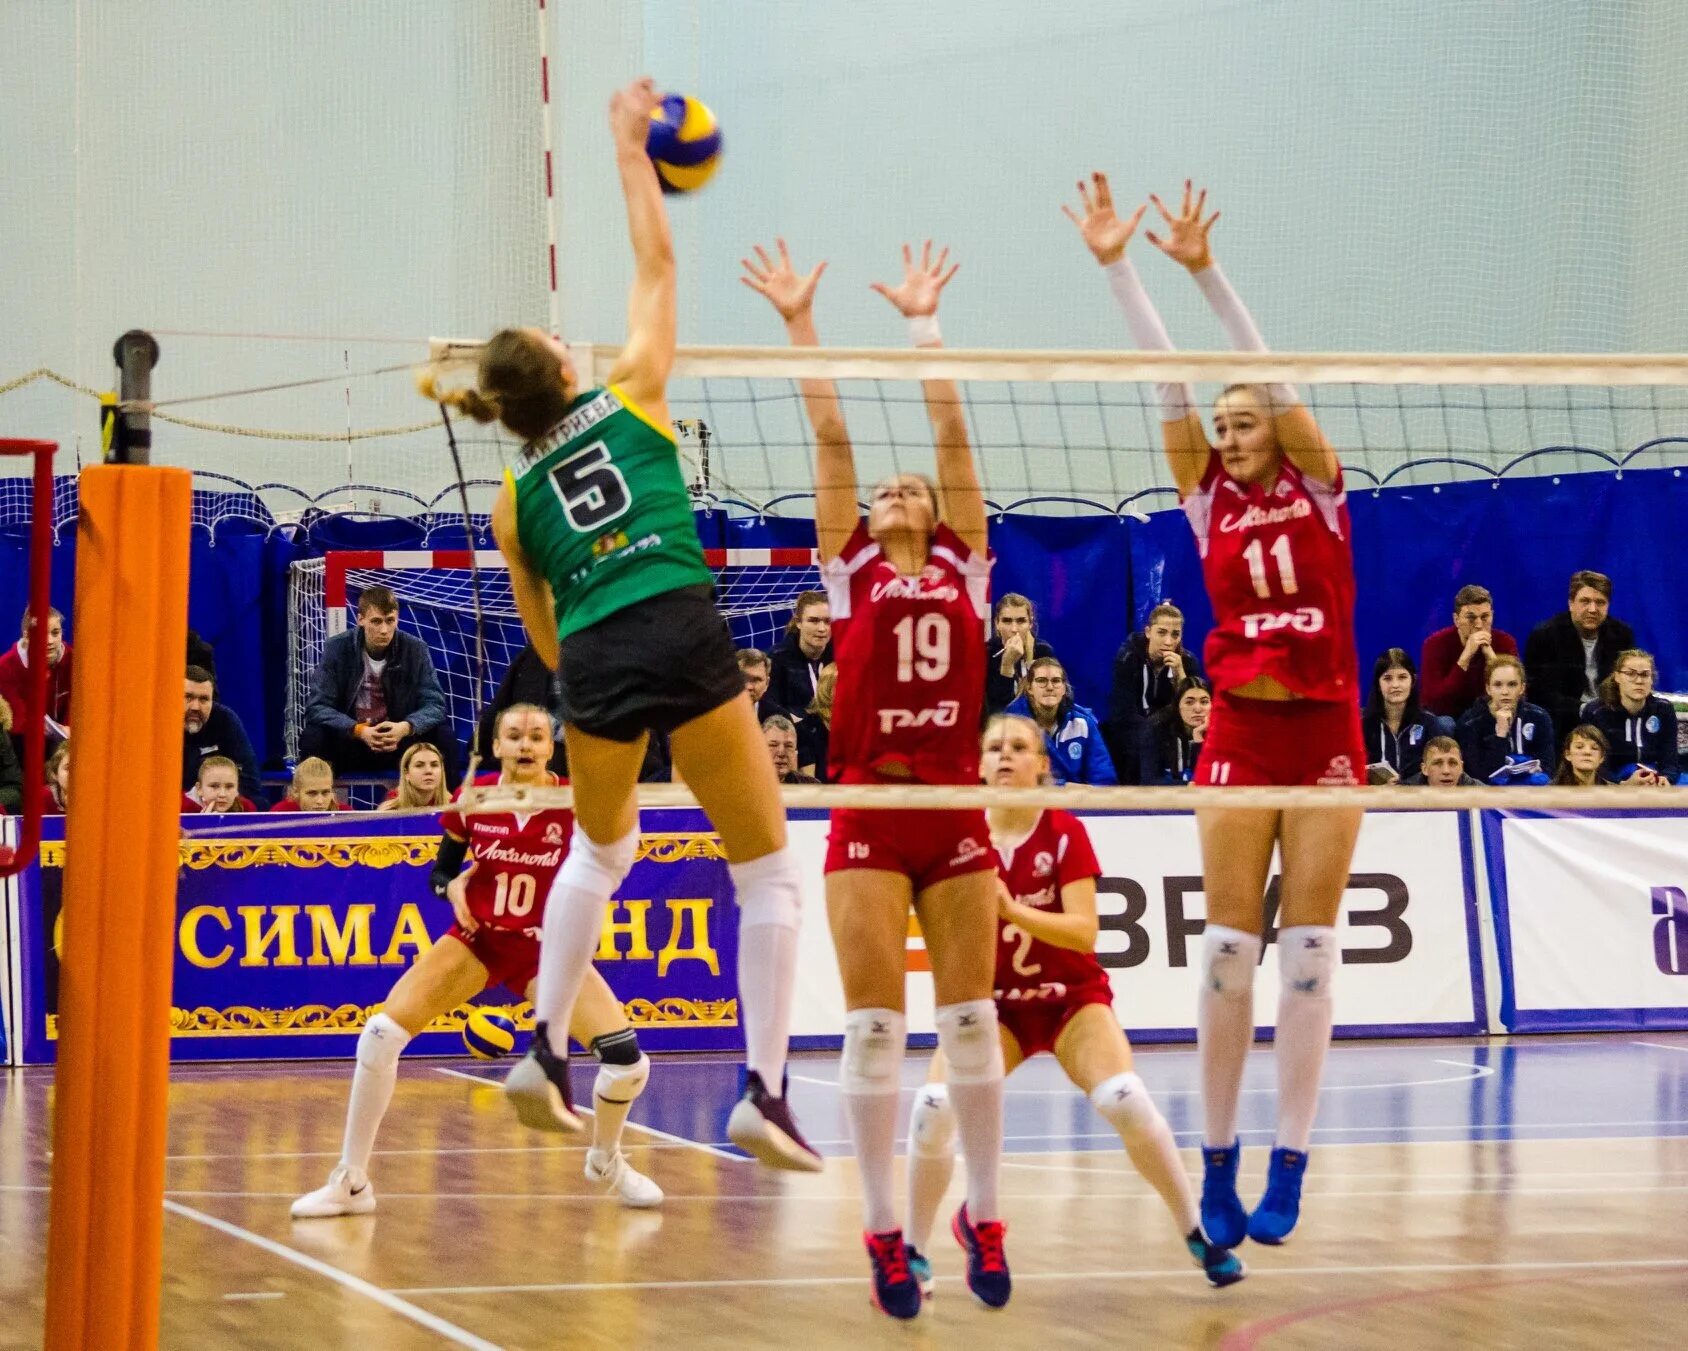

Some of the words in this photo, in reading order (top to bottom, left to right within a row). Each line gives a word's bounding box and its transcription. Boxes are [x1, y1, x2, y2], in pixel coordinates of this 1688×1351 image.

[548, 440, 632, 533] 5
[1243, 534, 1298, 599] 11
[894, 613, 951, 682] 19
[1210, 760, 1231, 784] 11
[473, 822, 510, 835] macron
[493, 872, 536, 917] 10
[179, 904, 434, 969] СИМА
[594, 899, 720, 977] НД
[1002, 923, 1042, 977] 2
